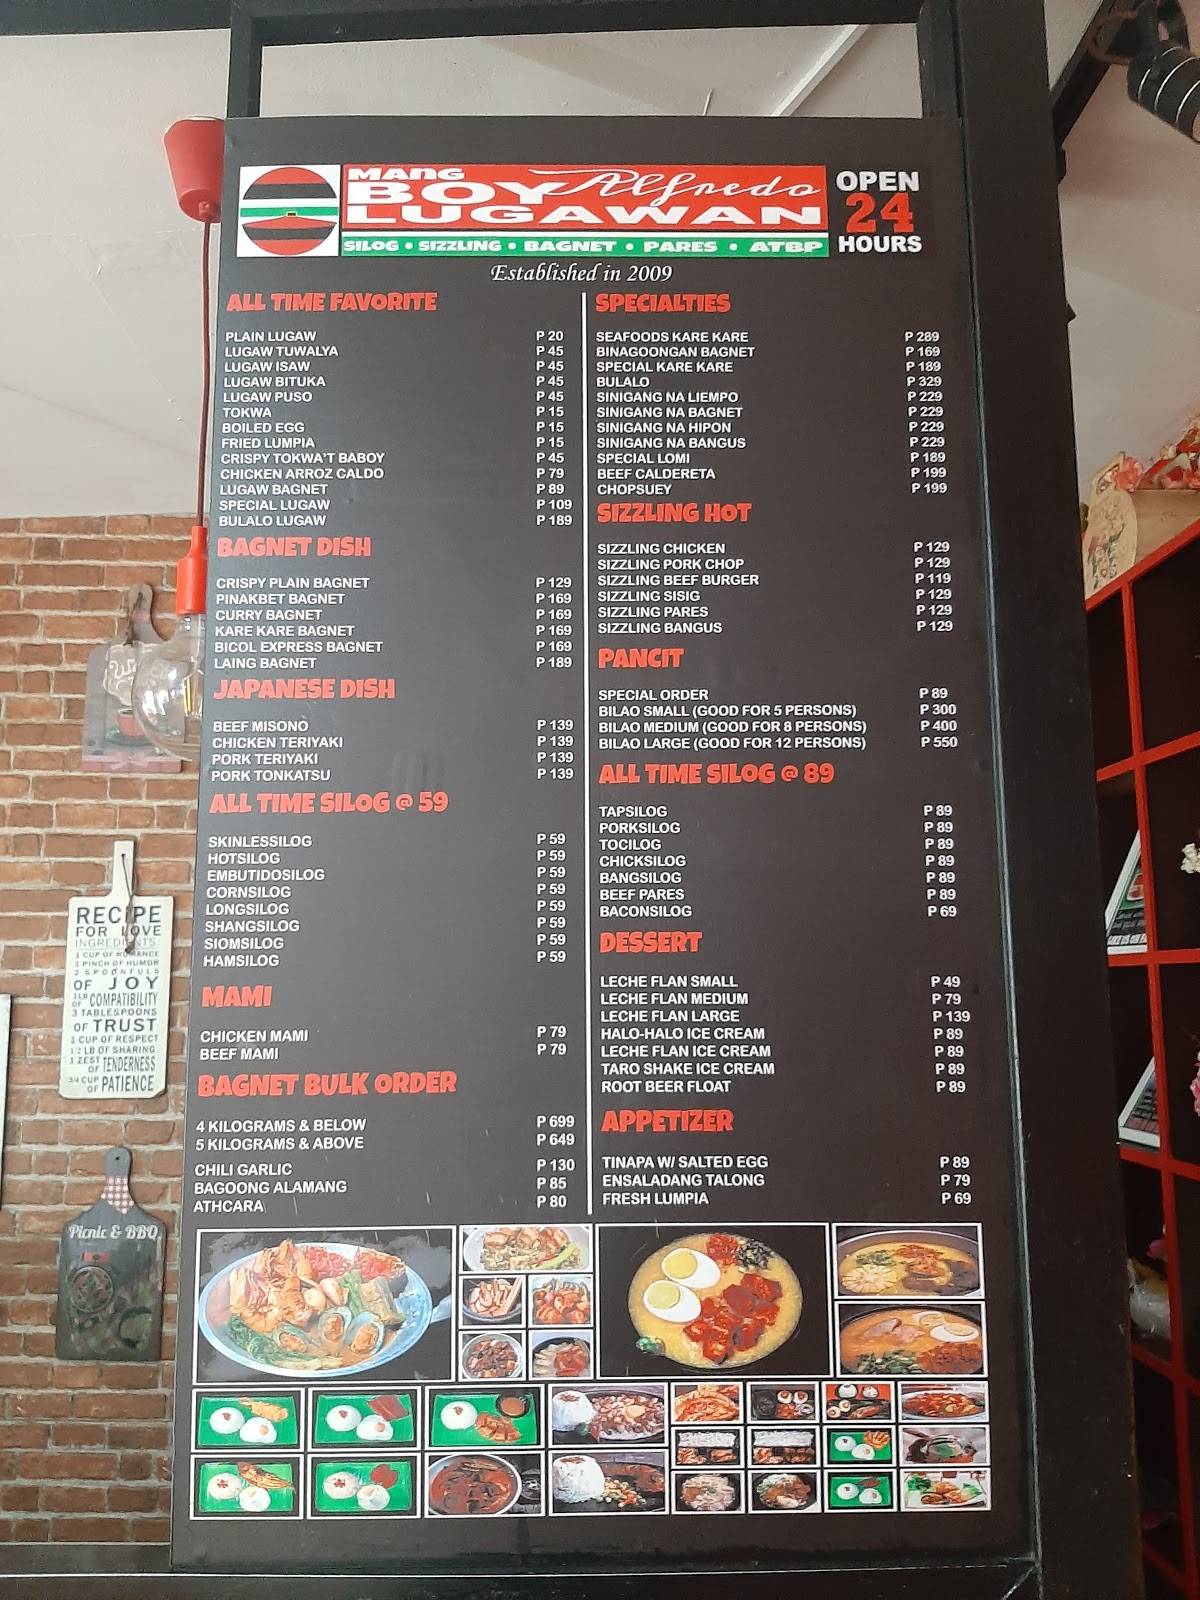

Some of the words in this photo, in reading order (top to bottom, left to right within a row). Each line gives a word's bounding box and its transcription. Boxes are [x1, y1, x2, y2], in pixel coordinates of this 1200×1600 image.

[347, 181, 569, 204] BOY
[528, 169, 821, 207] Alfredo
[836, 171, 920, 192] OPEN
[346, 205, 822, 225] LUGAWAN
[845, 192, 915, 234] 24
[343, 240, 400, 252] SILOG
[418, 240, 502, 252] SIZZLING
[524, 240, 618, 252] BAGNET
[643, 240, 718, 253] PARES
[750, 241, 823, 253] ATBP
[838, 235, 923, 253] HOURS
[490, 262, 602, 282] Established
[604, 262, 621, 282] in
[628, 265, 673, 282] 2009
[227, 293, 265, 312] ALL
[272, 292, 325, 312] TIME
[329, 291, 437, 312] FAVORITE
[595, 292, 731, 314] SPECIALTIES
[226, 331, 264, 342] PLAIN
[268, 331, 316, 342] LUGAW
[537, 330, 545, 341] P
[548, 330, 564, 341] 20
[596, 331, 669, 342] SEAFOODS
[672, 331, 709, 342] KARE
[712, 332, 749, 342] KARE
[905, 331, 914, 342] P
[916, 331, 940, 342] 289
[597, 422, 663, 433] SINIGANG
[666, 422, 686, 433] NA
[689, 422, 731, 433] HIPON
[221, 453, 270, 464] CRISPY
[273, 452, 335, 464] TOKWA'T
[339, 452, 385, 463] BABOY
[537, 452, 545, 463] P
[548, 452, 564, 463] 45
[597, 484, 672, 495] CHOPSUEY
[219, 515, 273, 526] BULALO
[276, 515, 326, 526] LUGAW
[537, 515, 545, 525] P
[549, 515, 572, 525] 189
[597, 502, 700, 524] SIZZLING
[704, 502, 752, 524] HOT
[219, 537, 311, 557] BAGNET
[317, 537, 372, 557] DISH
[216, 577, 266, 589] CRISPY
[270, 577, 309, 588] PLAIN
[314, 577, 370, 588] BAGNET
[536, 577, 545, 588] P
[549, 577, 572, 588] 129
[598, 575, 660, 586] SIZZLING
[664, 575, 699, 585] BEEF
[702, 574, 759, 585] BURGER
[915, 573, 925, 584] P
[927, 573, 951, 584] 119
[215, 642, 257, 653] BICOL
[261, 641, 323, 652] EXPRESS
[327, 641, 383, 652] BAGNET
[598, 647, 685, 669] PANCIT
[214, 678, 335, 699] JAPANESE
[340, 678, 396, 700] DISH
[599, 722, 640, 733] BILAO
[644, 722, 699, 733] MEDIUM
[702, 721, 749, 735] (GOOD
[752, 721, 781, 732] FOR
[784, 721, 792, 732] 8
[795, 720, 867, 734] PERSONS)
[213, 737, 276, 748] CHICKEN
[280, 737, 343, 748] TERIYAKI
[538, 736, 546, 746] P
[550, 735, 573, 746] 139
[598, 763, 640, 784] ALL
[644, 763, 702, 784] TIME
[706, 763, 776, 784] SILOG
[781, 764, 799, 782] @
[803, 762, 835, 784] 89
[210, 794, 251, 813] ALL
[257, 793, 314, 813] TIME
[320, 792, 390, 814] SILOG
[396, 795, 413, 811] @
[420, 791, 449, 813] 59
[209, 835, 312, 848] SKINLESSILOG
[537, 833, 546, 844] P
[549, 833, 565, 844] 59
[600, 855, 686, 867] CHICKSILOG
[208, 869, 325, 881] EMBUTIDOSILOG
[77, 906, 161, 924] RECIPE
[76, 926, 107, 937] FOR
[599, 930, 703, 954] DESSERT
[203, 954, 279, 967] HAMSILOG
[74, 980, 92, 990] OF
[109, 976, 158, 990] JOY
[89, 992, 158, 1007] COMPATIBILITY
[202, 985, 272, 1008] MAMI
[81, 1008, 157, 1017] TABLESPOONS
[74, 1023, 88, 1032] OF
[93, 1019, 157, 1032] TRUST
[78, 1036, 98, 1044] CUP
[601, 1027, 683, 1040] HALO-HALO
[687, 1027, 711, 1039] ICE
[714, 1027, 765, 1040] CREAM
[200, 1048, 237, 1060] BEEF
[241, 1048, 278, 1060] MAMI
[537, 1043, 547, 1055] P
[550, 1043, 566, 1055] 79
[103, 1056, 156, 1072] TENDERNESS
[81, 1076, 100, 1084] CUP
[102, 1075, 154, 1092] PATIENCE
[197, 1072, 298, 1098] BAGNET
[304, 1072, 369, 1097] BULK
[374, 1071, 458, 1094] ORDER
[87, 1085, 99, 1093] OF
[196, 1121, 205, 1132] 4
[209, 1120, 295, 1133] KILOGRAMS
[299, 1119, 310, 1132] &
[313, 1118, 366, 1131] BELOW
[537, 1115, 546, 1128] P
[549, 1115, 575, 1128] 699
[601, 1108, 734, 1133] APPETIZER
[603, 1192, 651, 1205] FRESH
[655, 1192, 709, 1205] LUMPIA
[68, 1224, 107, 1239] Picnic
[110, 1225, 122, 1239] &
